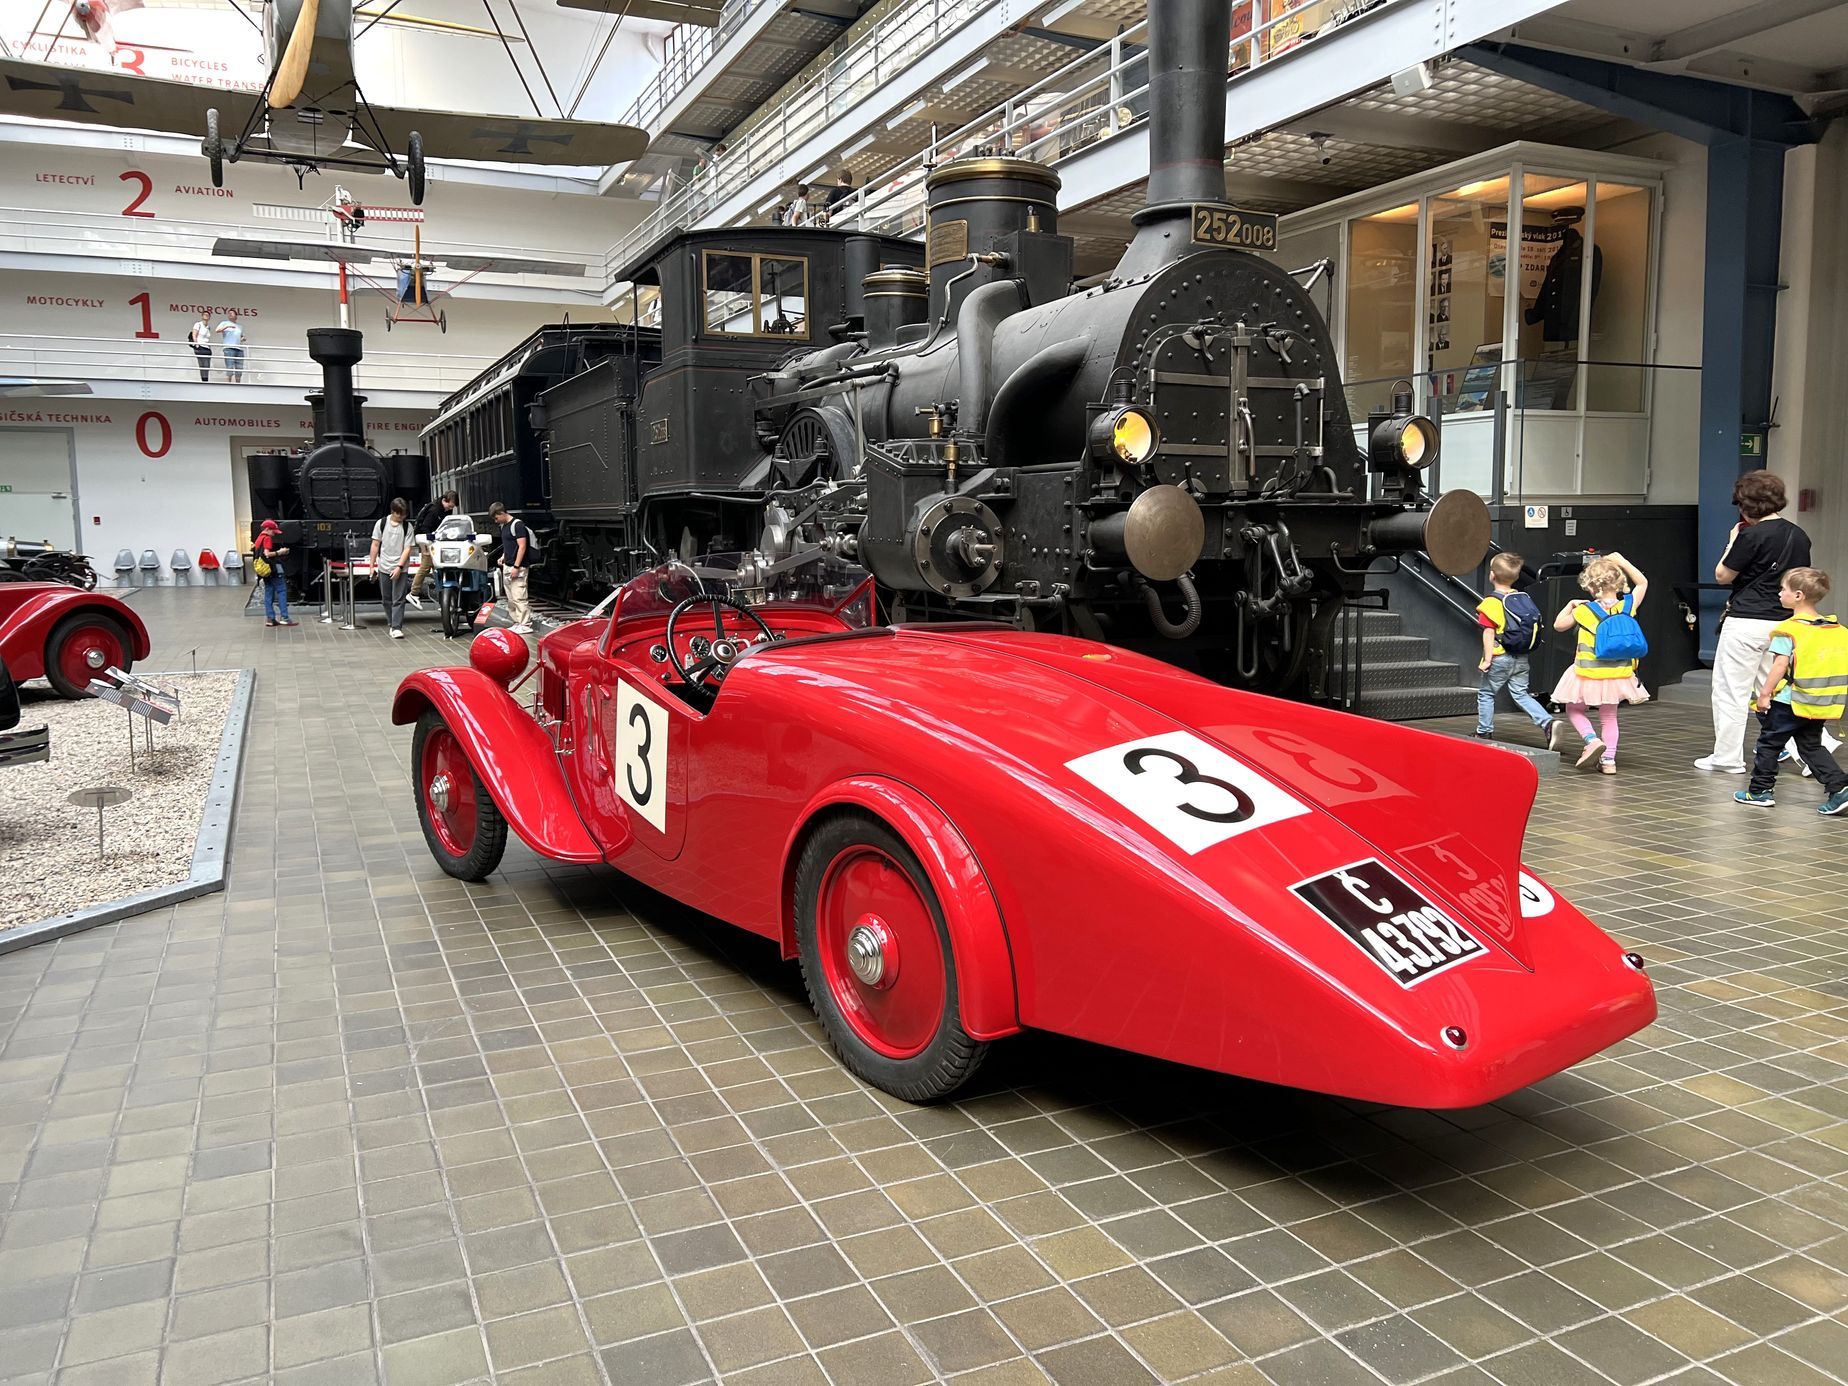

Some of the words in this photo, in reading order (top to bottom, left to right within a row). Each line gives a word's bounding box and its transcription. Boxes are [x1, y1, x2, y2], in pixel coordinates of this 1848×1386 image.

[12, 41, 87, 56] CYKLISTIKA
[171, 57, 228, 72] BICYCLES
[36, 174, 95, 186] LETECTVÍ
[118, 170, 155, 218] 2
[175, 185, 234, 198] AVIATION
[27, 296, 104, 308] MOTOCYKLY
[128, 292, 160, 339] 1
[48, 413, 112, 424] TECHNIKA
[194, 418, 281, 428] AUTOMOBILES
[367, 422, 390, 431] FIRE
[136, 411, 172, 458] 0
[627, 703, 652, 806] 3
[1123, 748, 1255, 823] 3
